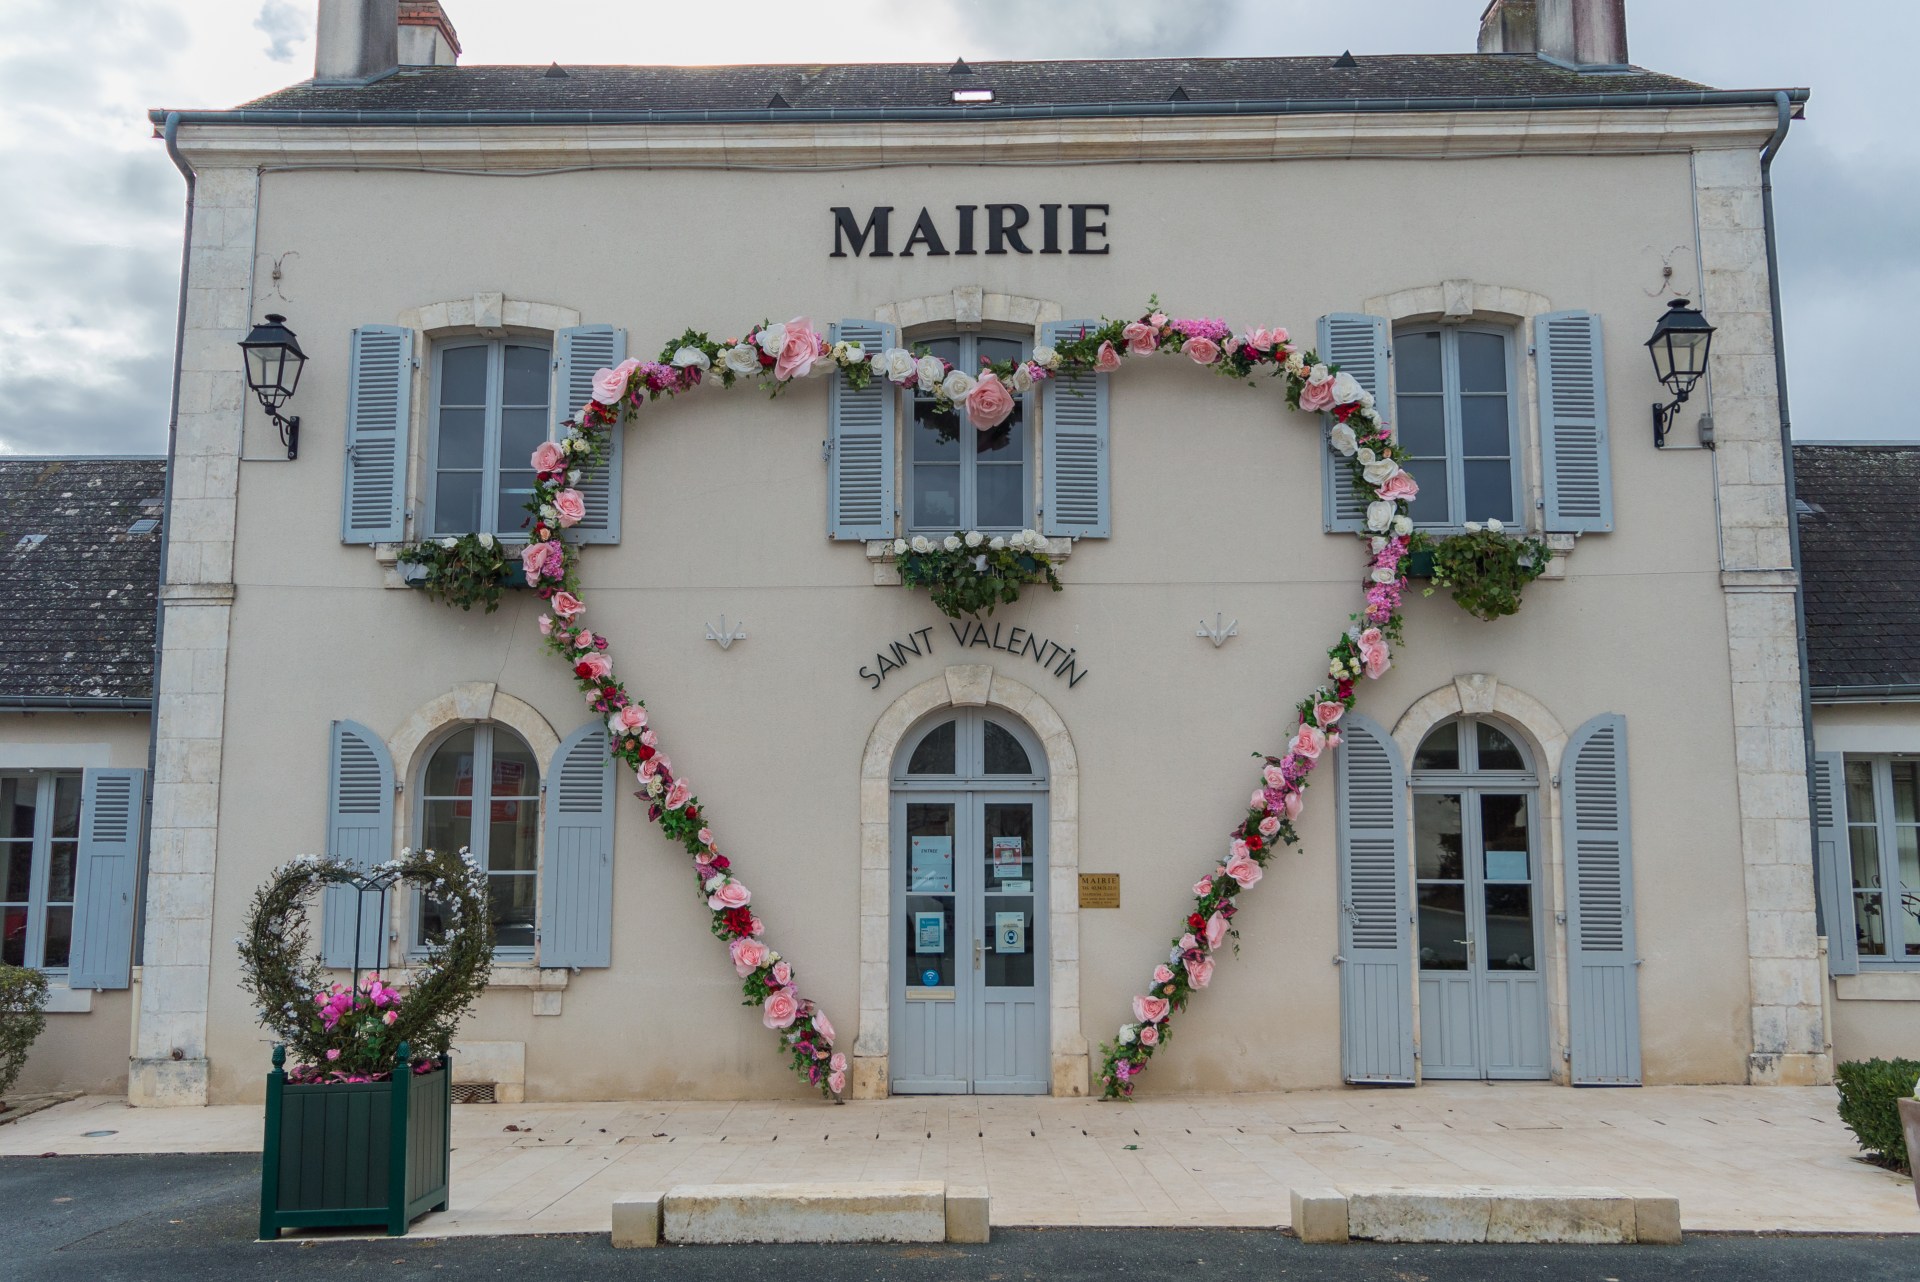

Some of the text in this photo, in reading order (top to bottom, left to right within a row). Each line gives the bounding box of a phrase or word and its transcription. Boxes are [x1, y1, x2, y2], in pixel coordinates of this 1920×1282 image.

[829, 203, 1110, 257] MAIRIE
[858, 621, 1088, 690] SAINT VALENTIN
